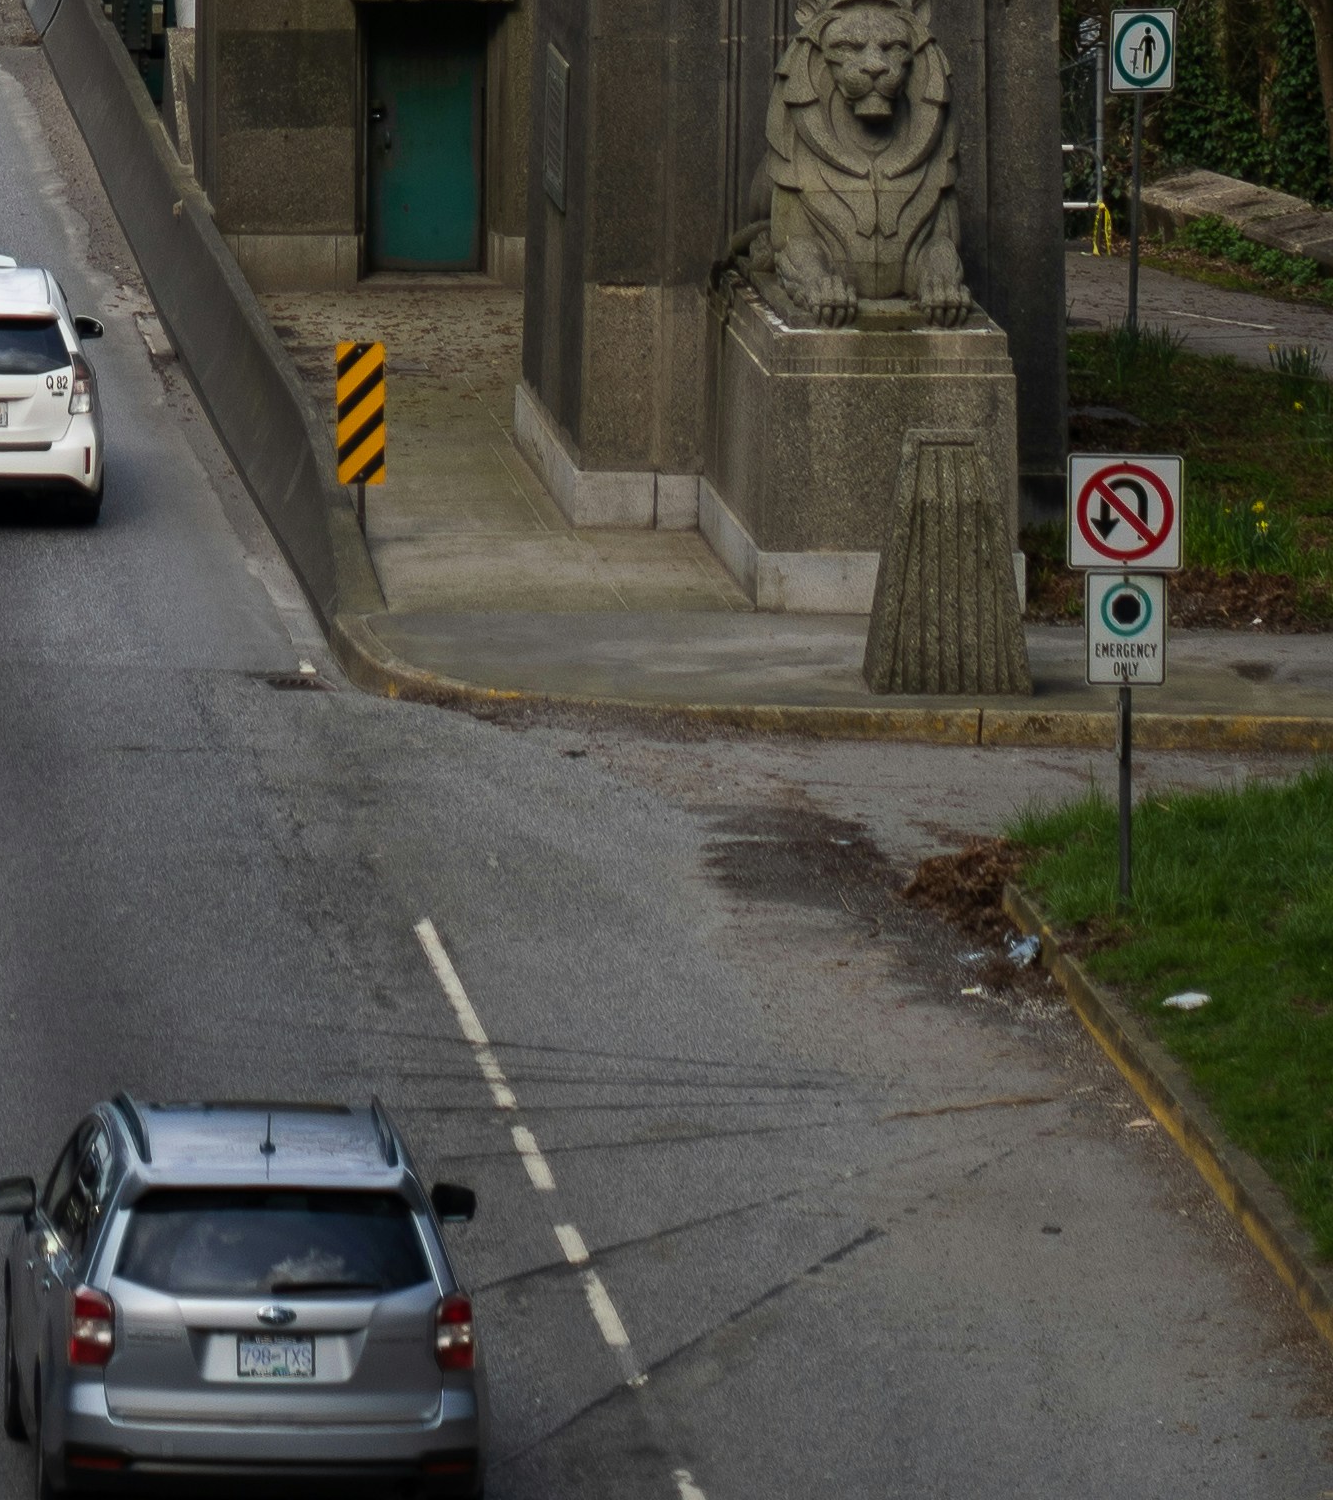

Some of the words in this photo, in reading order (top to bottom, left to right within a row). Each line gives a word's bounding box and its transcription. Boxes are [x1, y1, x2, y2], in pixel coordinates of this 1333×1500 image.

[45, 374, 54, 390] Q
[56, 375, 69, 390] 82
[1095, 643, 1158, 658] EMERGENCY
[1113, 661, 1139, 677] ONLY
